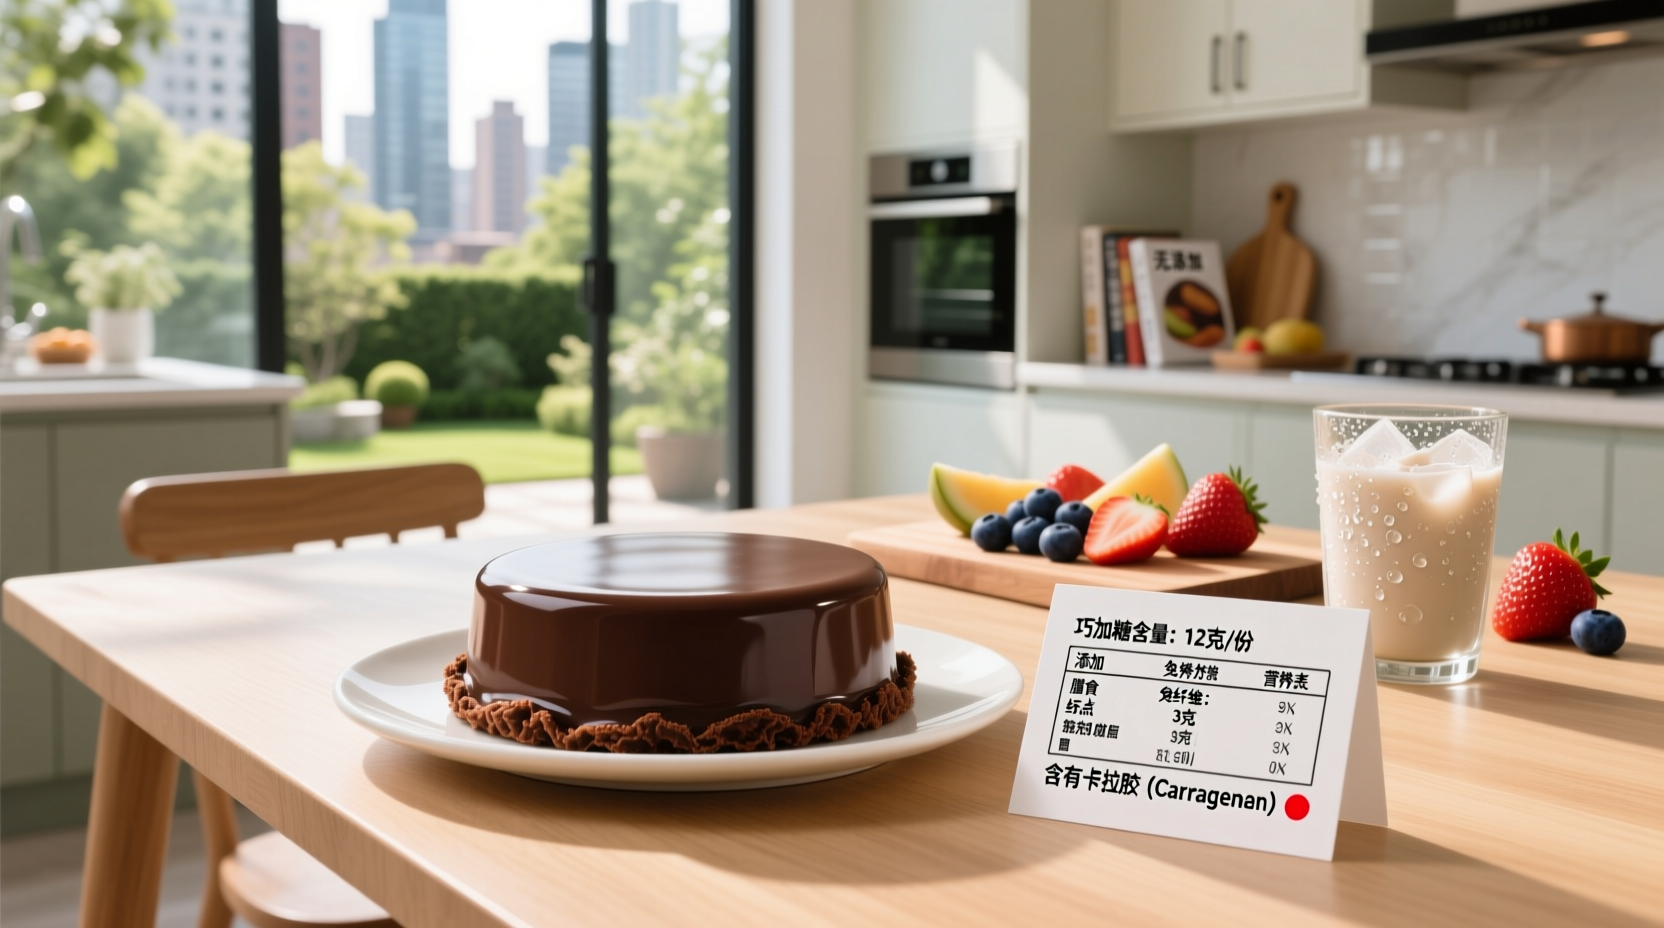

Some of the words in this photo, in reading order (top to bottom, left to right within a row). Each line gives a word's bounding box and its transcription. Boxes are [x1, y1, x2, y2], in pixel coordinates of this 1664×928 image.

[1172, 709, 1197, 726] 3克
[1045, 763, 1141, 796] 含有卡拉胶
[1147, 776, 1276, 816] (Carragenan)
